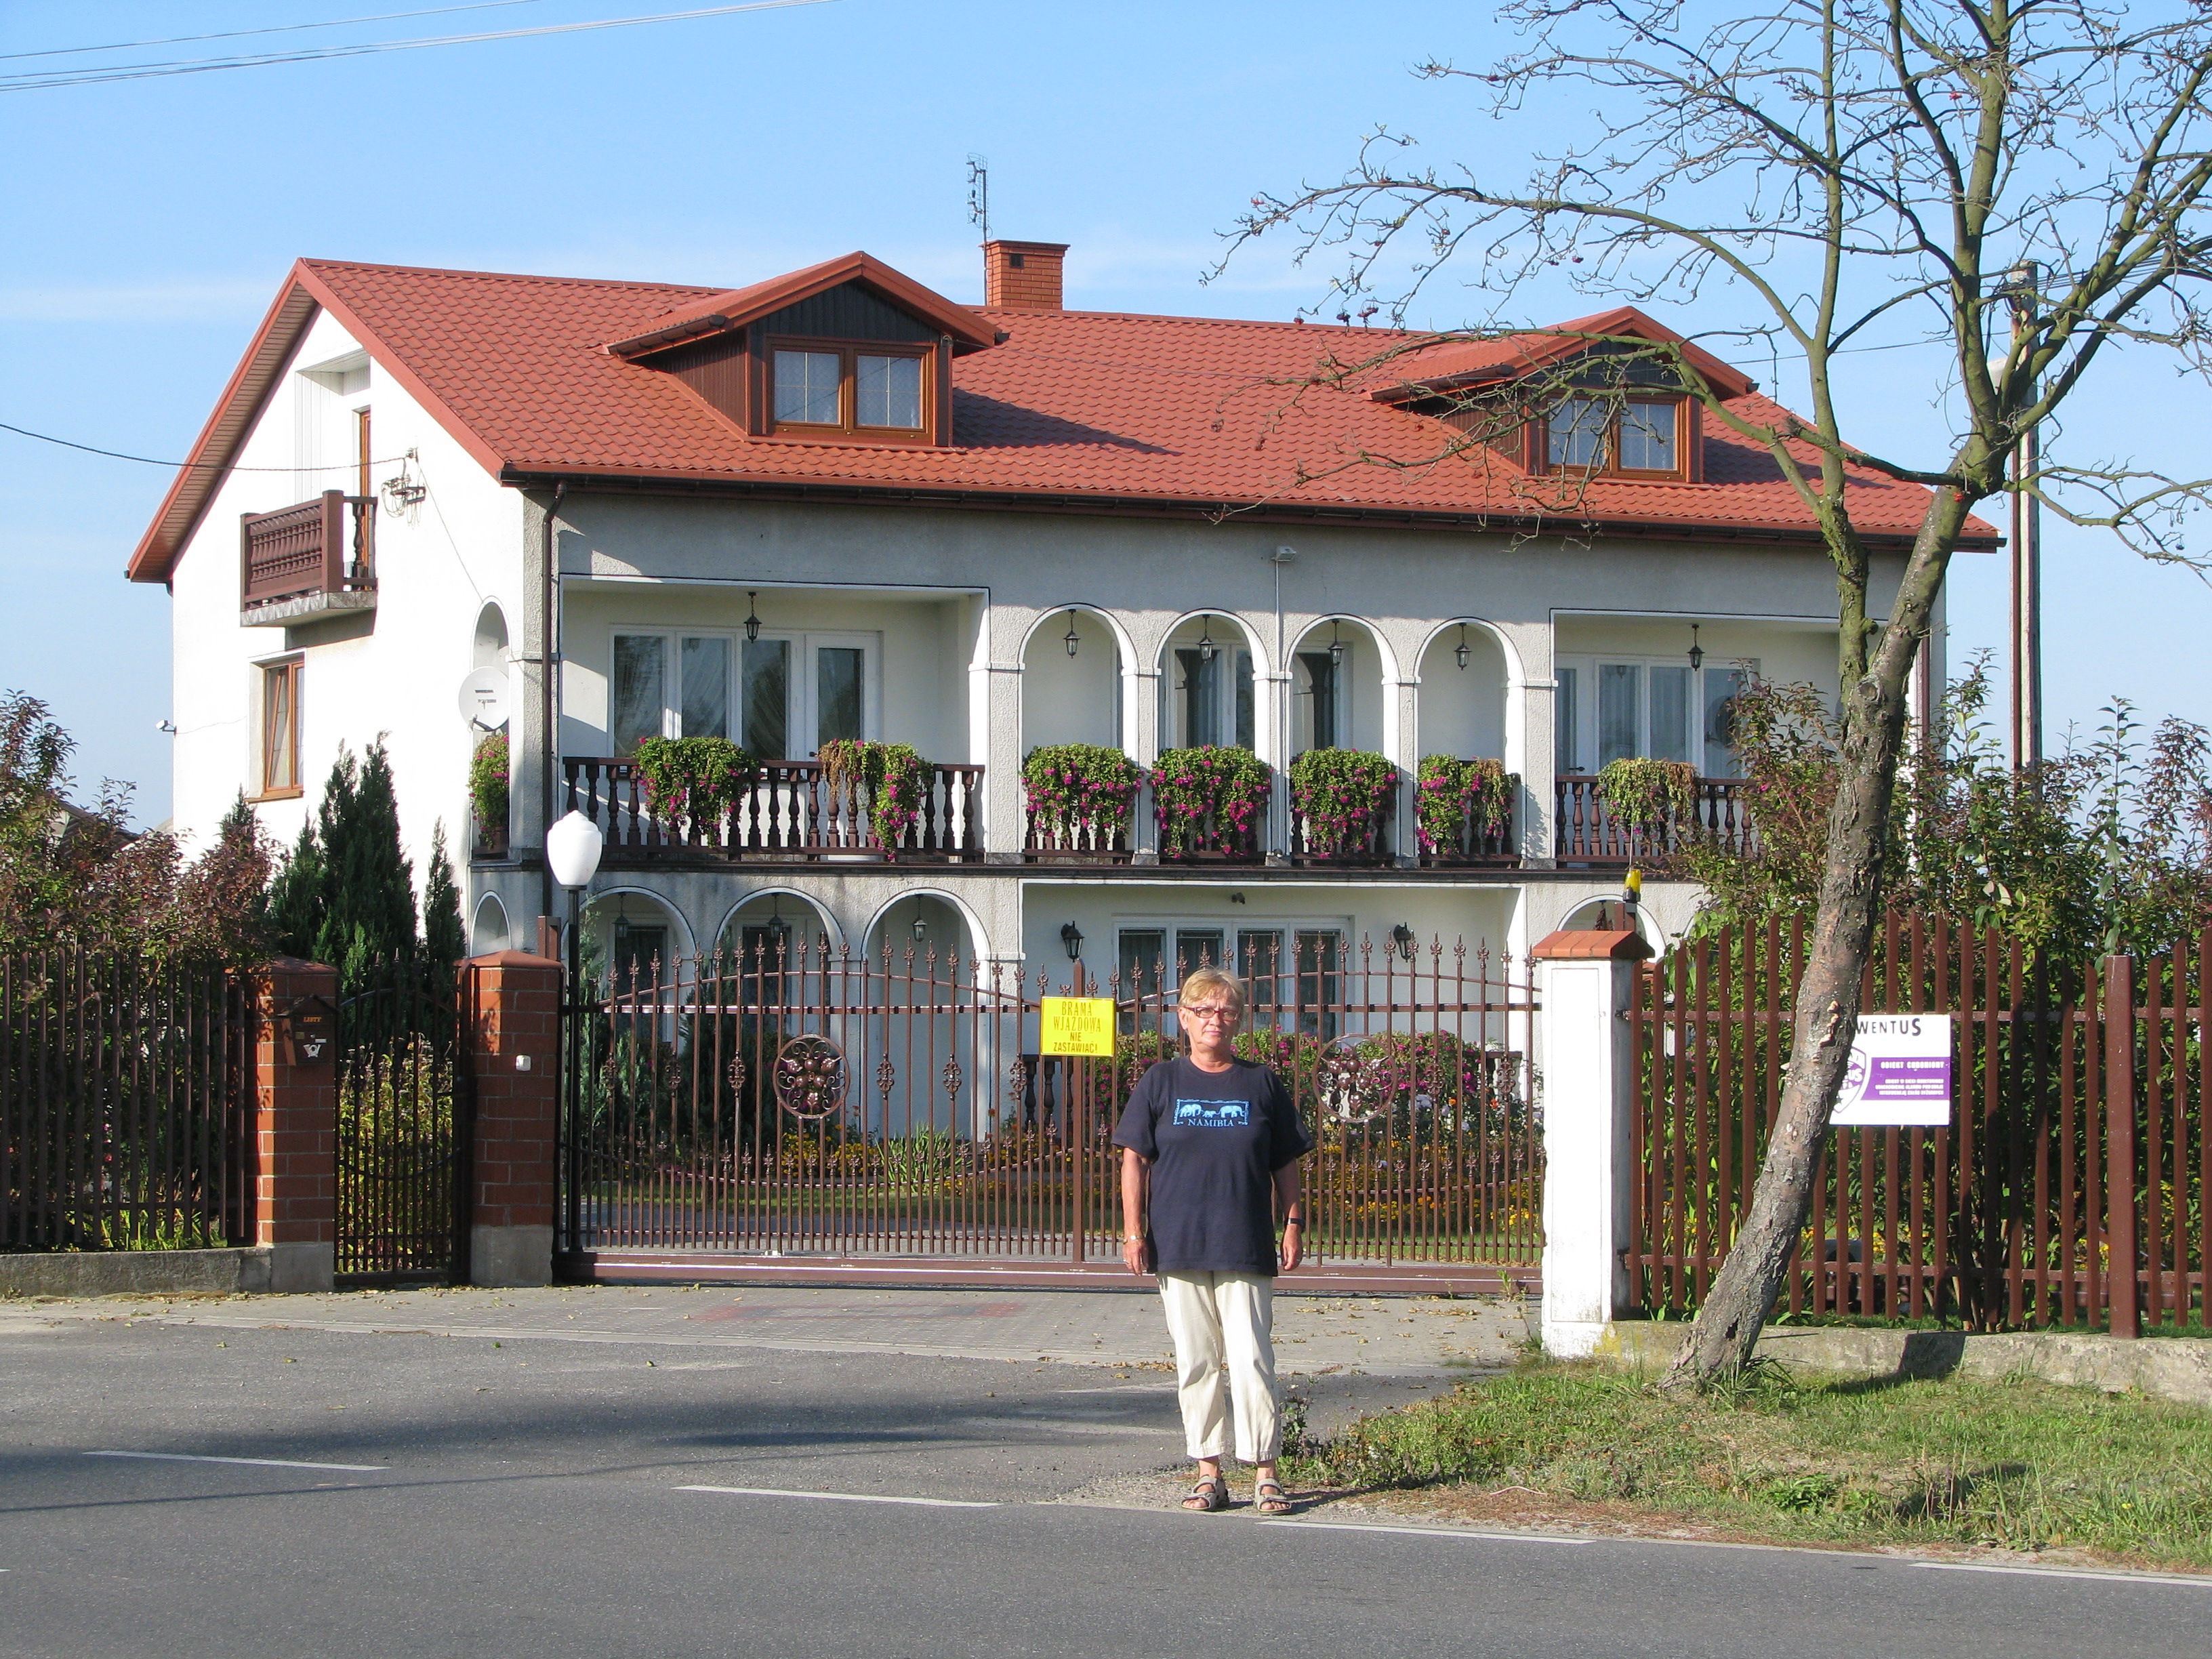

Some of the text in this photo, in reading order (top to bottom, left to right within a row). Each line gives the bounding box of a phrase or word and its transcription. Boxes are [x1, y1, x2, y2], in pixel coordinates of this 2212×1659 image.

[1061, 1001, 1092, 1017] BRAMA
[1053, 1016, 1101, 1032] WJAZDOWA
[1856, 1018, 1922, 1037] WENTUS
[1069, 1031, 1082, 1042] NIE
[1187, 1118, 1234, 1127] NAMIBIA
